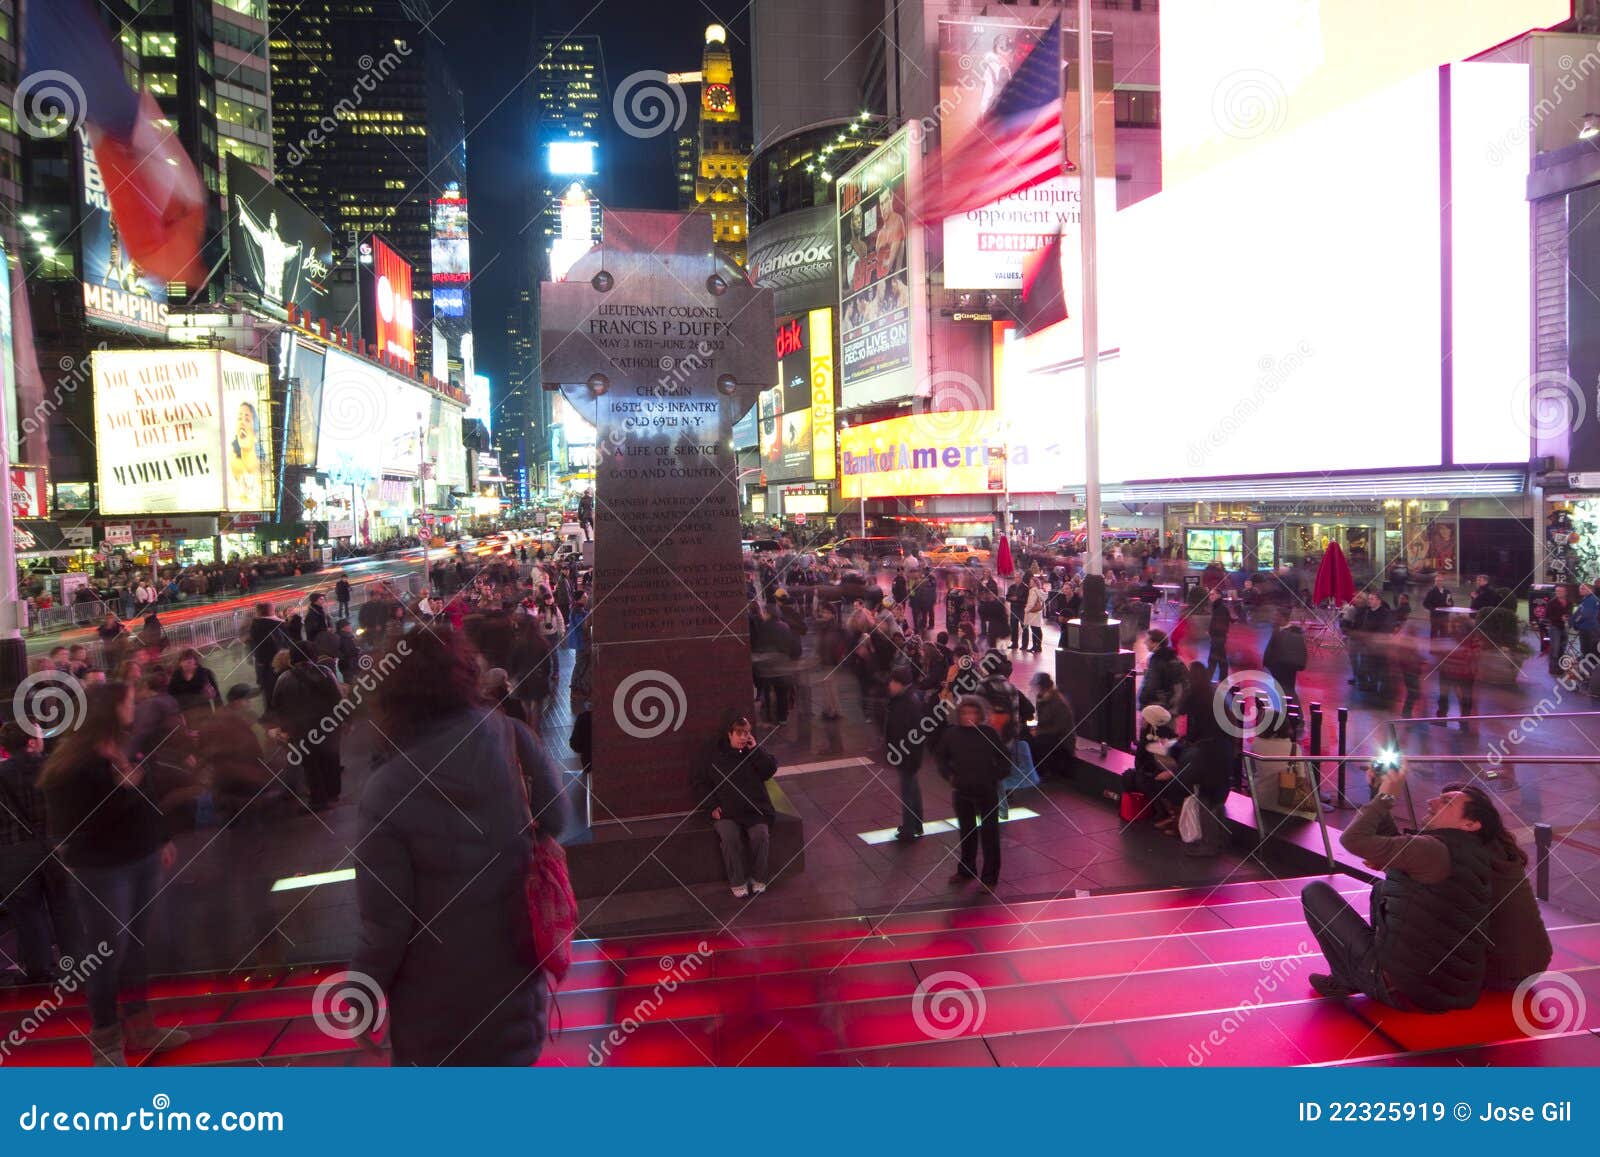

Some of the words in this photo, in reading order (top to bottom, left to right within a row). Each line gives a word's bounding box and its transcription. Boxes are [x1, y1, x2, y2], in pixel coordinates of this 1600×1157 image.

[1033, 184, 1080, 206] injure
[966, 209, 1048, 226] opponent
[83, 281, 169, 326] MEMPHIS
[598, 304, 666, 318] LIEUTENANT
[668, 306, 722, 319] COLONEL
[589, 319, 657, 335] FRANCIS
[679, 321, 734, 337] DUFFY
[775, 319, 803, 359] dak
[866, 331, 888, 350] LIVE
[890, 323, 907, 341] ON
[600, 338, 621, 348] MAY
[610, 357, 671, 369] CATHOLI
[103, 368, 130, 389] YOU
[138, 360, 199, 385] ALREADY
[134, 384, 177, 406] KNOW
[813, 355, 834, 435] Kodak
[107, 407, 161, 431] YOU'RE
[163, 401, 213, 424] GONNA
[669, 402, 719, 412] INFANTRY
[626, 416, 649, 427] OLD
[134, 425, 169, 448] LOVE
[627, 446, 650, 456] LIFE
[655, 446, 670, 456] OF
[674, 445, 720, 456] SERVICE
[843, 447, 878, 475] Bank
[879, 444, 897, 472] of
[898, 438, 1029, 471] Ameria
[113, 458, 172, 486] MAMMA
[174, 453, 210, 477] MIA!
[657, 457, 676, 467] FOR
[609, 469, 637, 480] GOD
[640, 469, 665, 479] AND
[670, 468, 723, 479] COUNTRY
